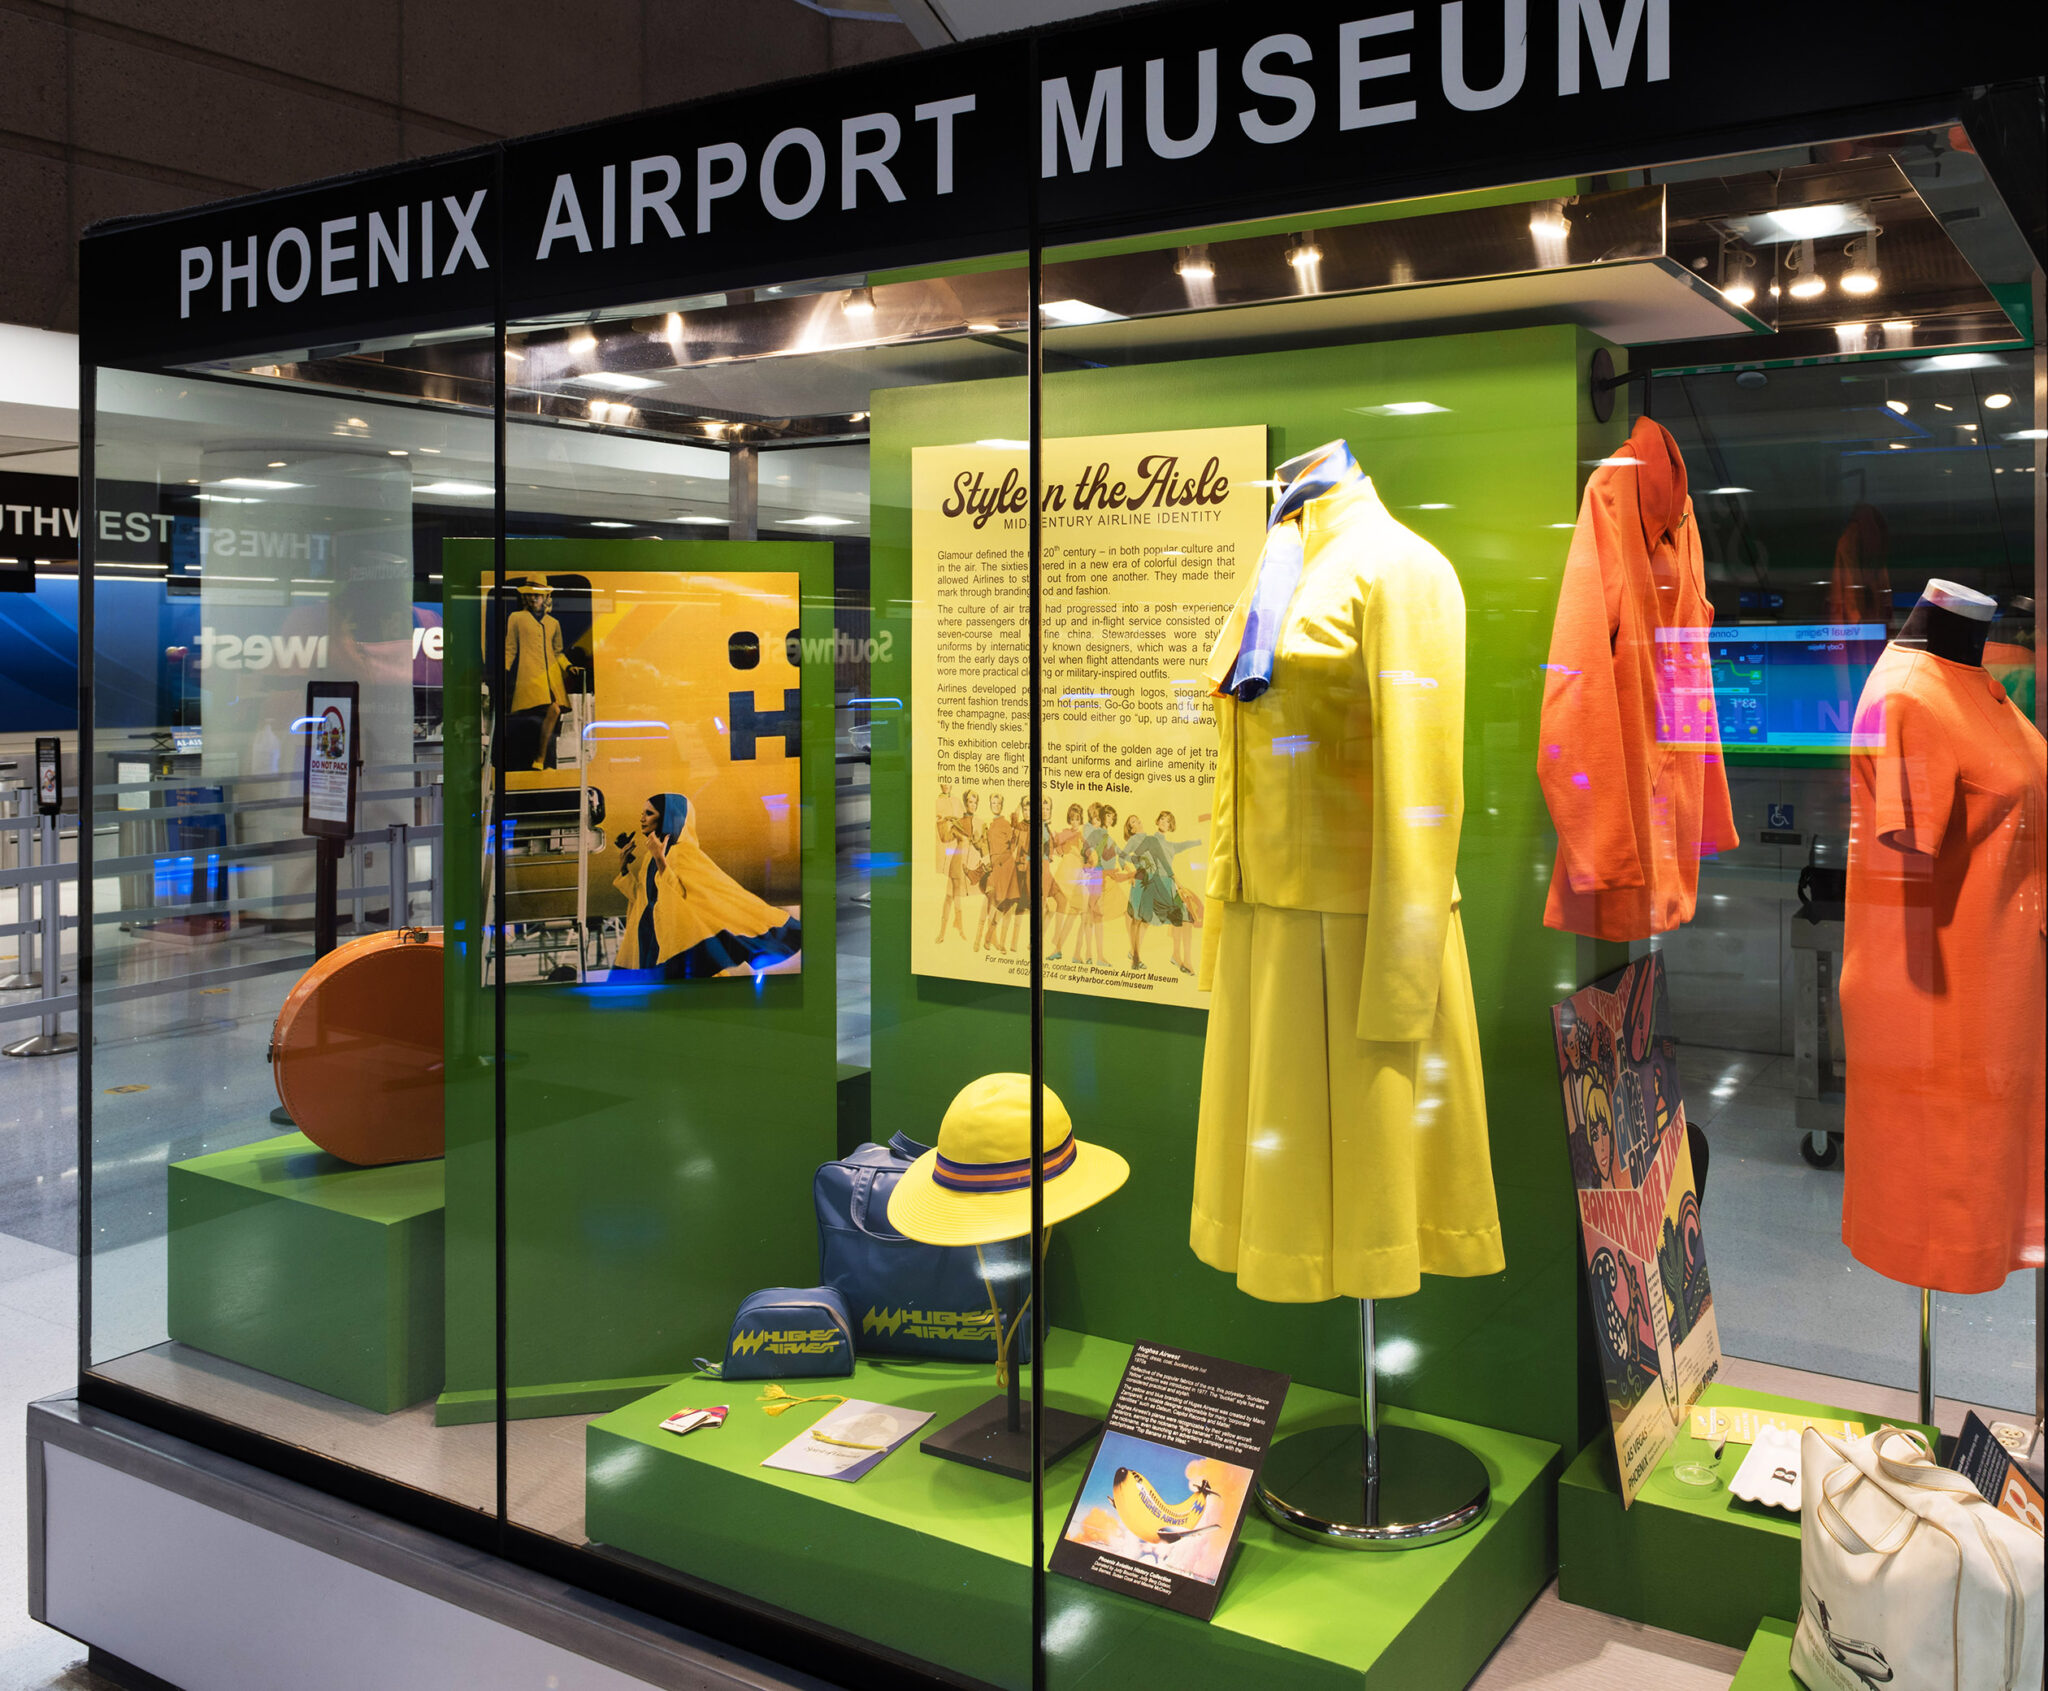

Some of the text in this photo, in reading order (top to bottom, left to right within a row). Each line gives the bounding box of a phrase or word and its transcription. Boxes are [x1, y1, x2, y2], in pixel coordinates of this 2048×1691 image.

[180, 0, 1670, 319] PHOENIX AIRPORT MUSEUM
[942, 468, 1028, 530] Style
[1073, 462, 1127, 511] the
[1126, 455, 1230, 512] Aisle
[1004, 510, 1221, 530] MID-ENTURY AIRLINE IDENTITY
[937, 542, 1235, 560] Glamour defined the century both popular culture and
[947, 555, 1235, 572] the The sixties colorful design that
[937, 569, 1235, 585] allowed Airlines another. They made their
[937, 584, 1110, 599] mark through fashion.
[957, 604, 985, 614] culture
[1066, 602, 1117, 616] progressed
[1154, 602, 1177, 614] posh
[937, 615, 1210, 629] where passengers in-flight service consisted
[937, 628, 1166, 639] seven-course meal china. Stewardesses
[936, 641, 1163, 655] uniforms designers, which
[974, 653, 1159, 667] early days when flight attendants
[982, 666, 1170, 681] practical military-inspired outfits.
[936, 682, 1168, 700] Airlines developed identity through logos,
[936, 695, 965, 706] current
[967, 695, 998, 706] fashion
[1104, 698, 1135, 710] Go-Go
[955, 708, 1116, 722] champagne, could either
[966, 720, 997, 733] friendly
[937, 736, 1152, 757] This exhibition spirit golden
[312, 760, 348, 771] DO NOT PACK
[952, 749, 1205, 773] display flight uniforms airline amenity
[974, 762, 1173, 784] 1960s This design gives
[981, 775, 1132, 793] when Style in the Aisle.
[985, 955, 1177, 984] For more contact the Phoenix Airport Museum
[1068, 973, 1153, 991] skyharbor.com/museum
[1580, 1190, 1648, 1262] BONANZA
[1642, 1160, 1666, 1262] AIR
[1660, 1110, 1684, 1196] LINES
[902, 1308, 1001, 1326] HUGHES
[764, 1328, 839, 1343] HUGHES
[903, 1325, 1003, 1341] AIRWEST
[764, 1341, 839, 1354] AIRWEST
[1137, 1345, 1180, 1360] Hughes Airwest
[1628, 1454, 1649, 1491] PHOENIX
[1771, 1467, 1797, 1487] B
[1139, 1491, 1188, 1526] HUGHES AIRWEST
